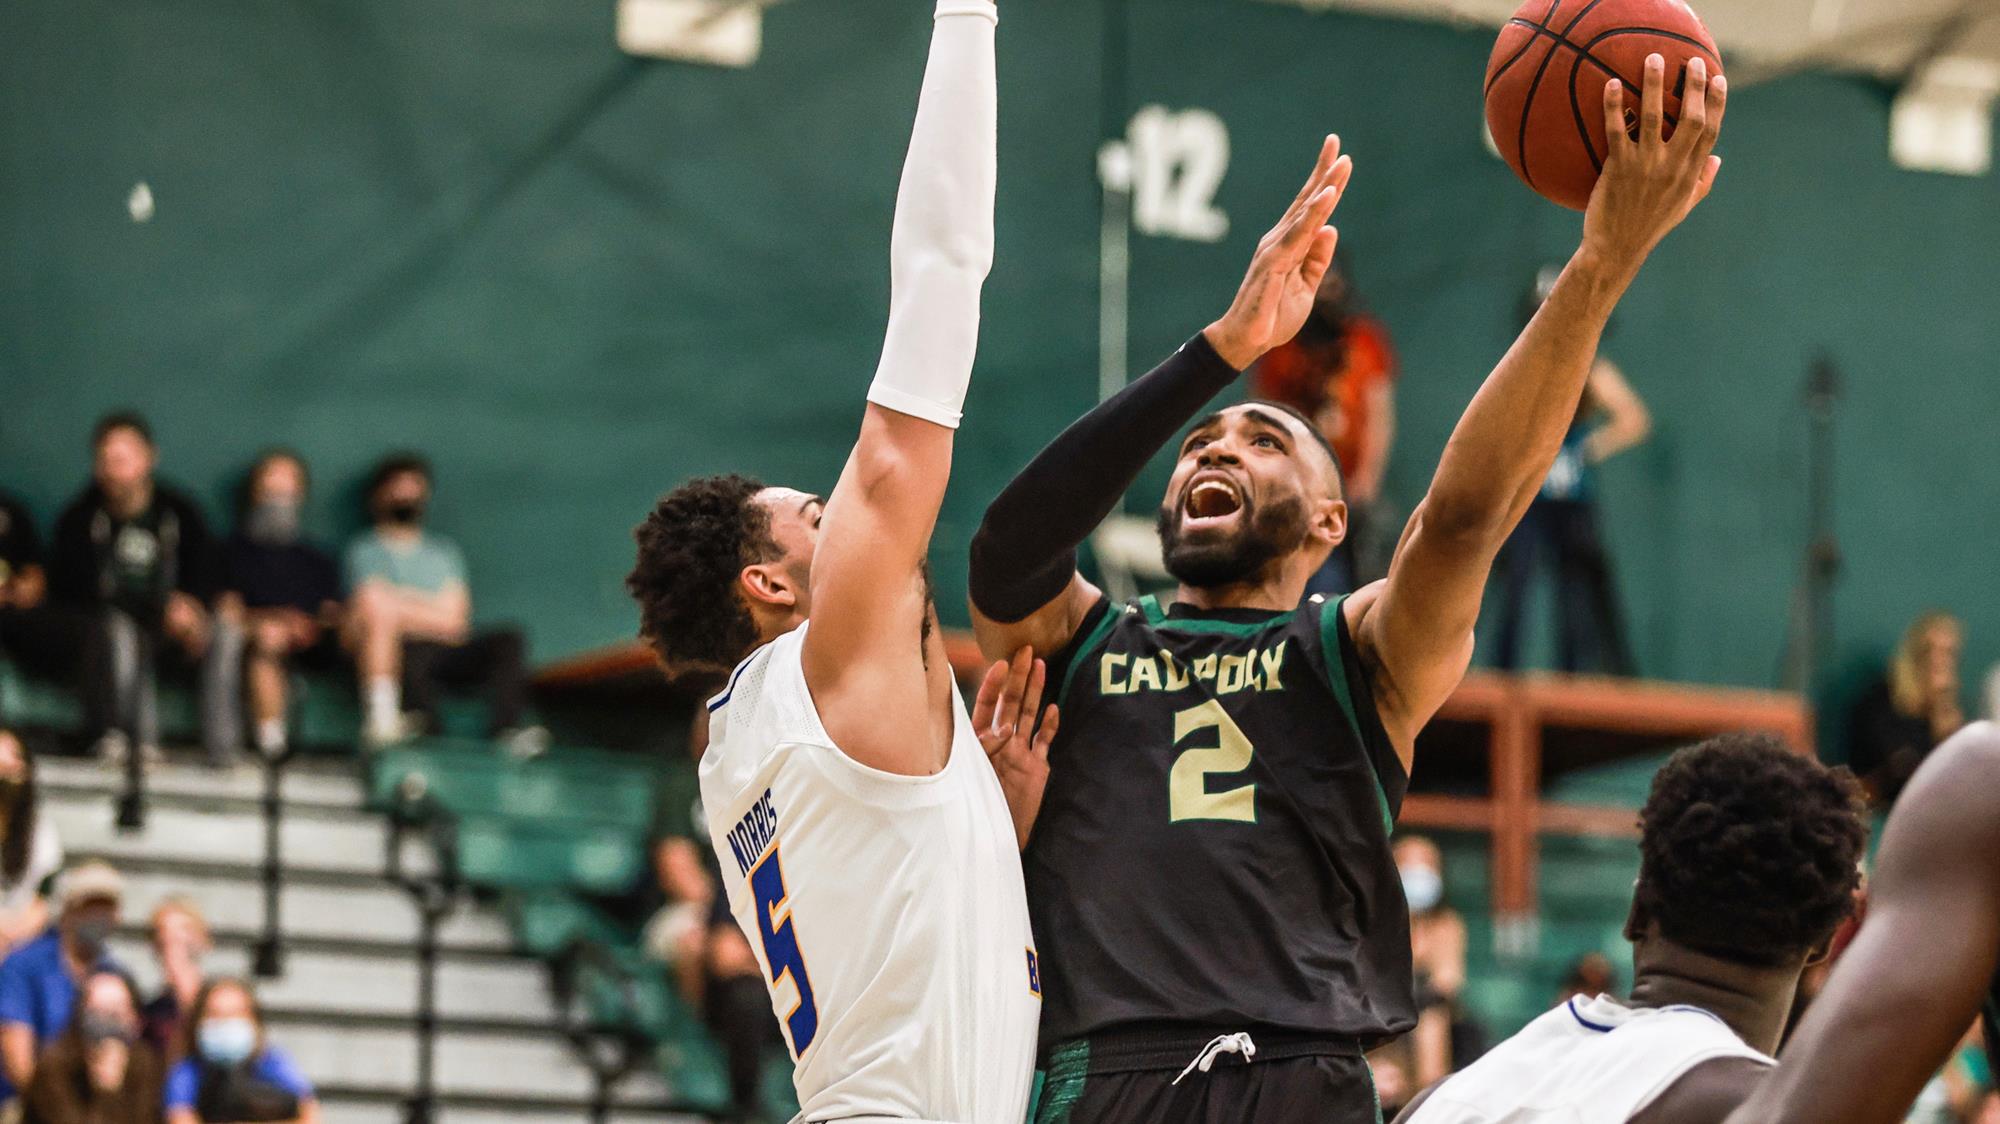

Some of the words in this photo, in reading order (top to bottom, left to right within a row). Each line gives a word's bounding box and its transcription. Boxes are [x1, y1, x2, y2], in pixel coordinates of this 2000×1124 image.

[1127, 106, 1230, 240] 12
[1101, 649, 1190, 695] CAL
[1169, 698, 1257, 823] 2
[726, 787, 777, 878] NORRIS
[748, 840, 818, 1061] 5
